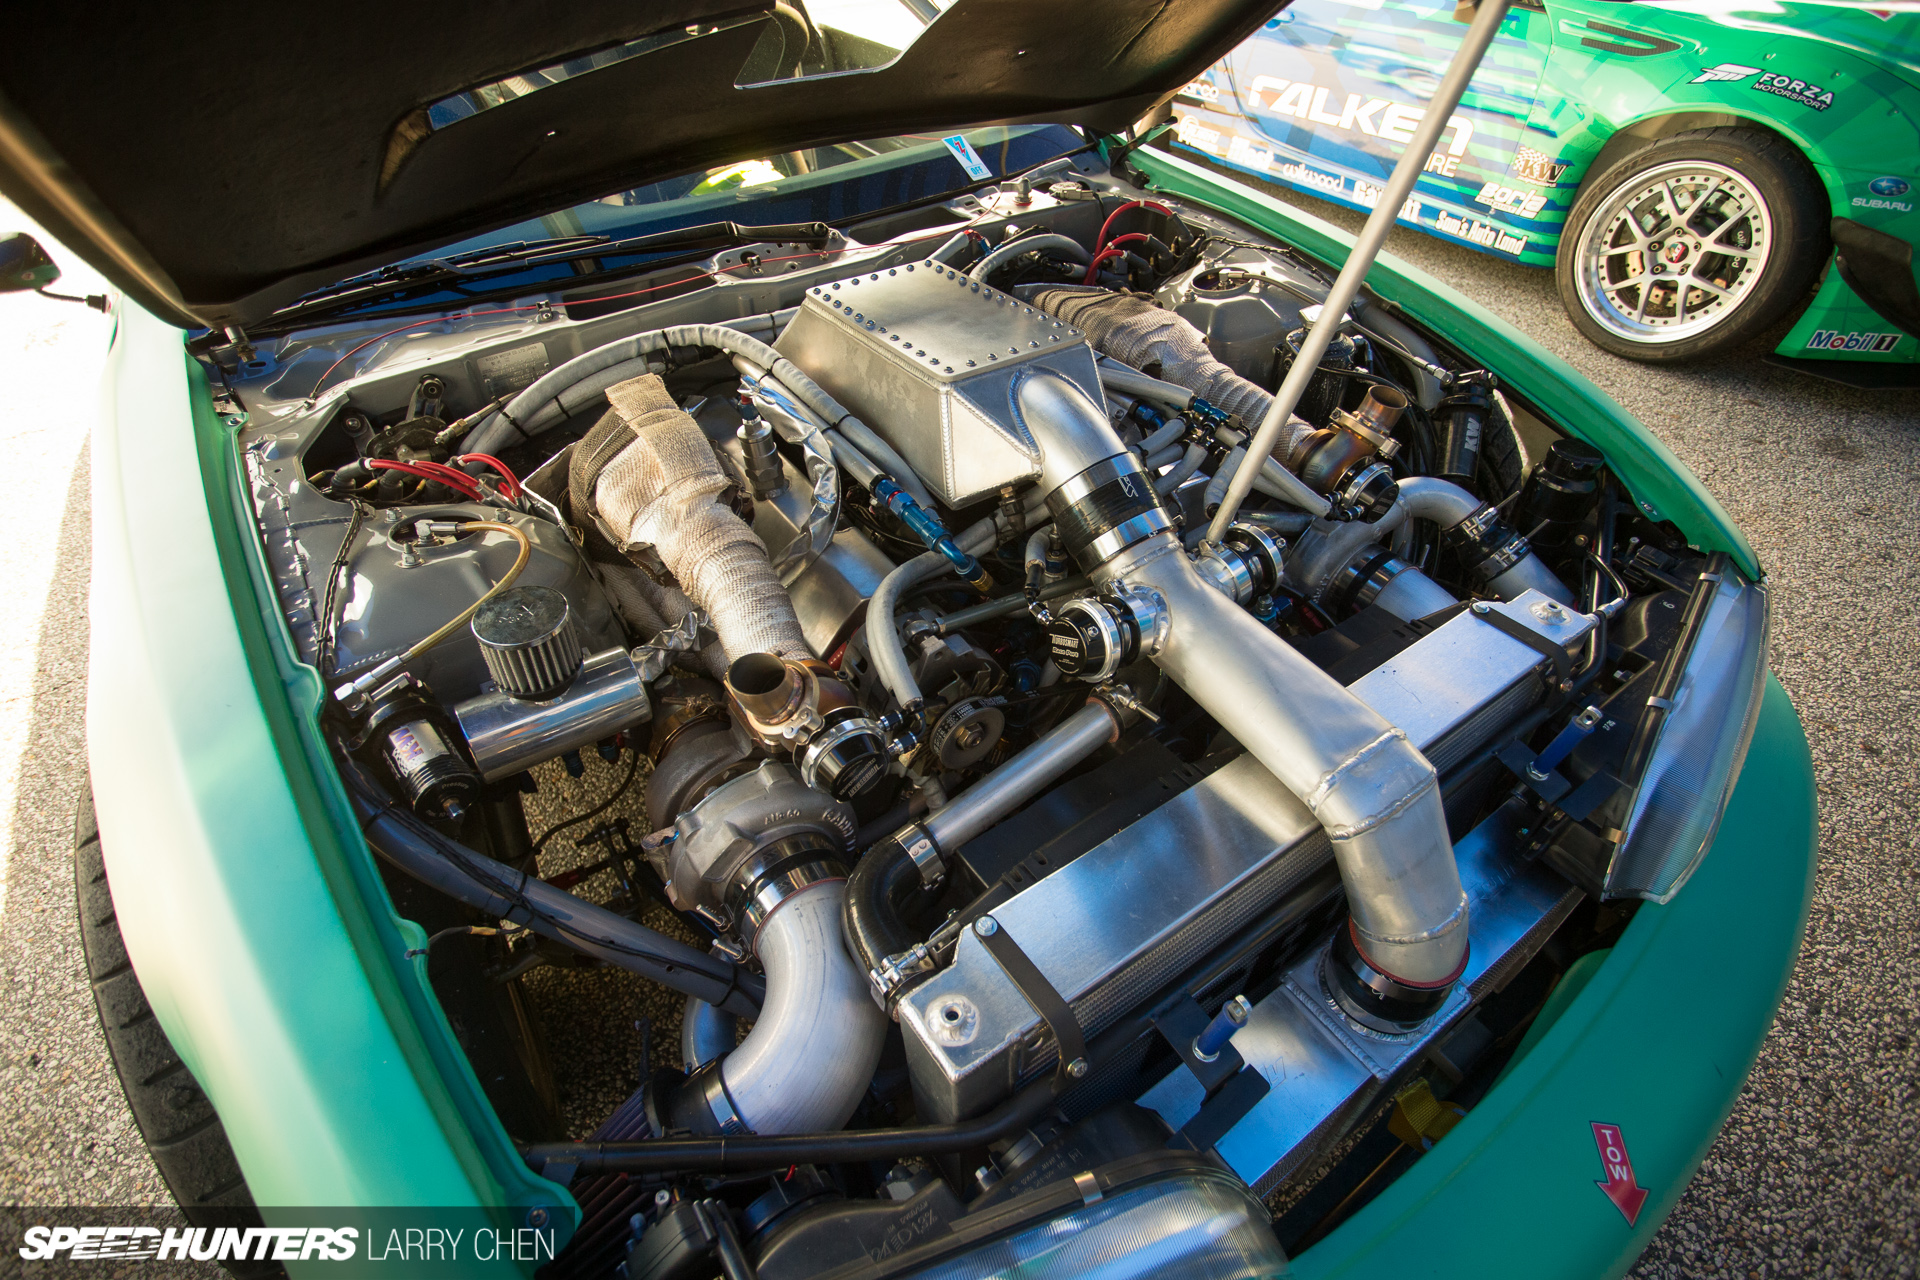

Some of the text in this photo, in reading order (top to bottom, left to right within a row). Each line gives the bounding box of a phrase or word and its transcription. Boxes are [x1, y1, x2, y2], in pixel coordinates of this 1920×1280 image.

[1752, 82, 1828, 112] MOTORSPORT
[1759, 73, 1835, 104] FORZA
[1248, 75, 1475, 157] FALKEN
[970, 165, 984, 176] OFF
[1283, 163, 1345, 192] wilwood
[1423, 152, 1461, 178] IRE
[1519, 158, 1567, 183] KW
[1480, 181, 1548, 219] Borla
[1851, 197, 1912, 212] SUBARU
[1435, 210, 1528, 255] Sam's Auto Land
[1807, 330, 1878, 351] Mobil
[1464, 417, 1479, 452] KW
[388, 726, 425, 762] KW
[1601, 1129, 1628, 1181] TOW
